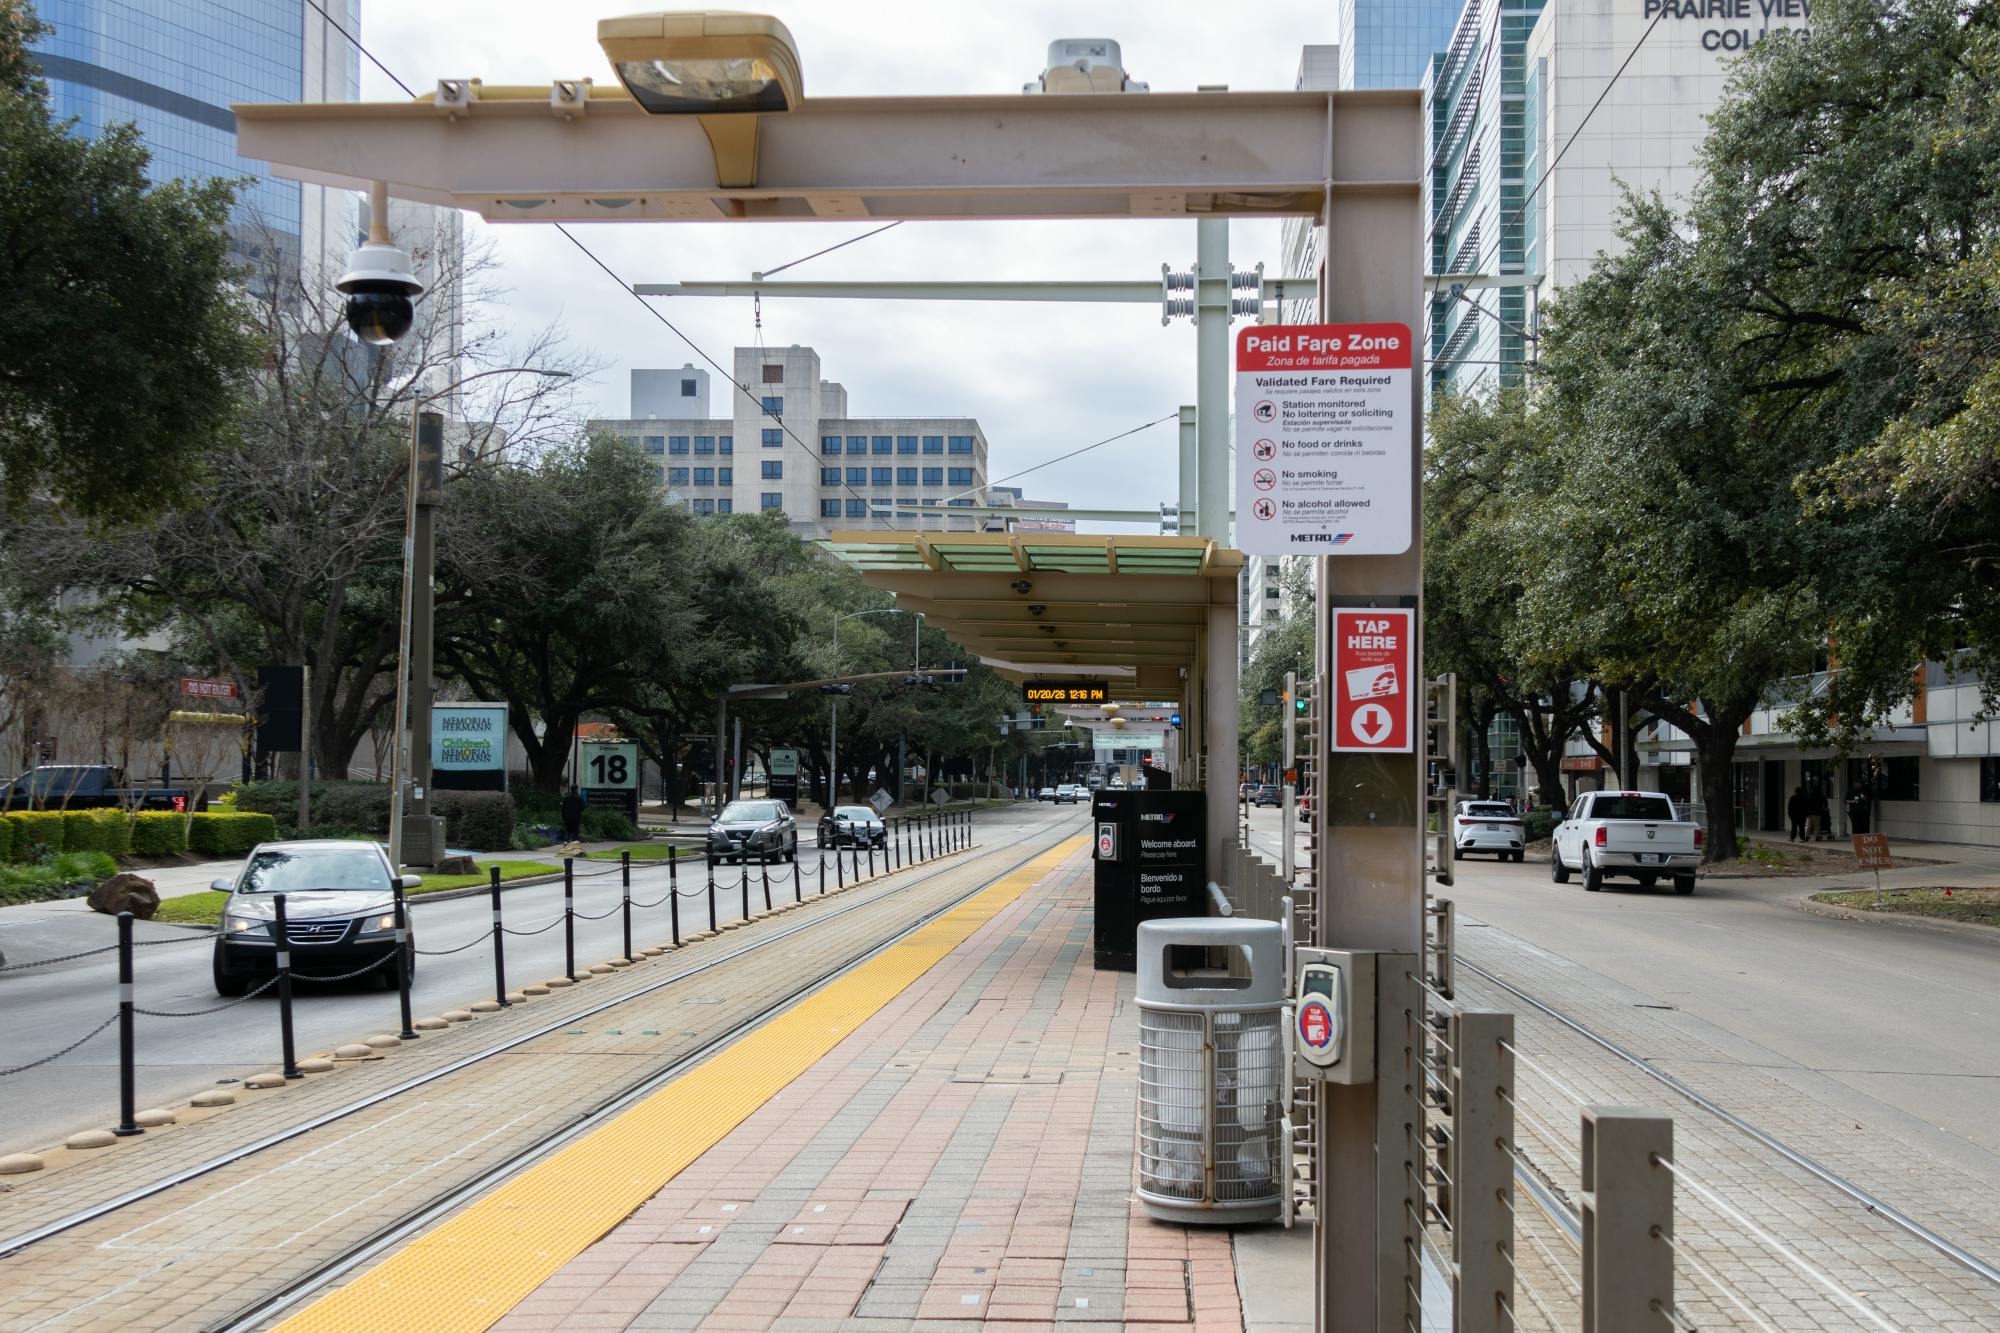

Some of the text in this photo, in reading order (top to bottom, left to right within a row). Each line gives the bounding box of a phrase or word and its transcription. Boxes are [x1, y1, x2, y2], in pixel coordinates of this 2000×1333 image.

[1644, 0, 1750, 19] PRAIRIE
[1246, 334, 1400, 352] Paid Fare Zone
[1266, 355, 1380, 367] Zona de tarifa pagada
[1255, 376, 1391, 387] Validated Fare Required
[1282, 400, 1365, 409] Station monitored
[1282, 410, 1296, 418] No
[1298, 410, 1336, 419] loitering
[1351, 409, 1393, 418] soliciting
[1282, 440, 1363, 448] No food or drinks
[1282, 469, 1338, 479] No smoking
[1282, 499, 1371, 508] No alcohol allowed
[1290, 534, 1332, 542] METRO
[1355, 620, 1390, 634] TAP
[1348, 636, 1397, 650] HERE
[188, 682, 231, 696] DO NOT ENTER
[1027, 690, 1103, 699] 01/20/26 12:16 PM
[442, 717, 492, 725] MEMORIAL
[442, 748, 491, 756] MEMORIAL
[441, 755, 491, 763] HERMANN
[590, 755, 628, 784] 18
[1141, 839, 1172, 848] Welcome
[1862, 847, 1883, 855] NOT
[1857, 856, 1892, 865] ENTER
[1141, 873, 1178, 882] Bienvenido
